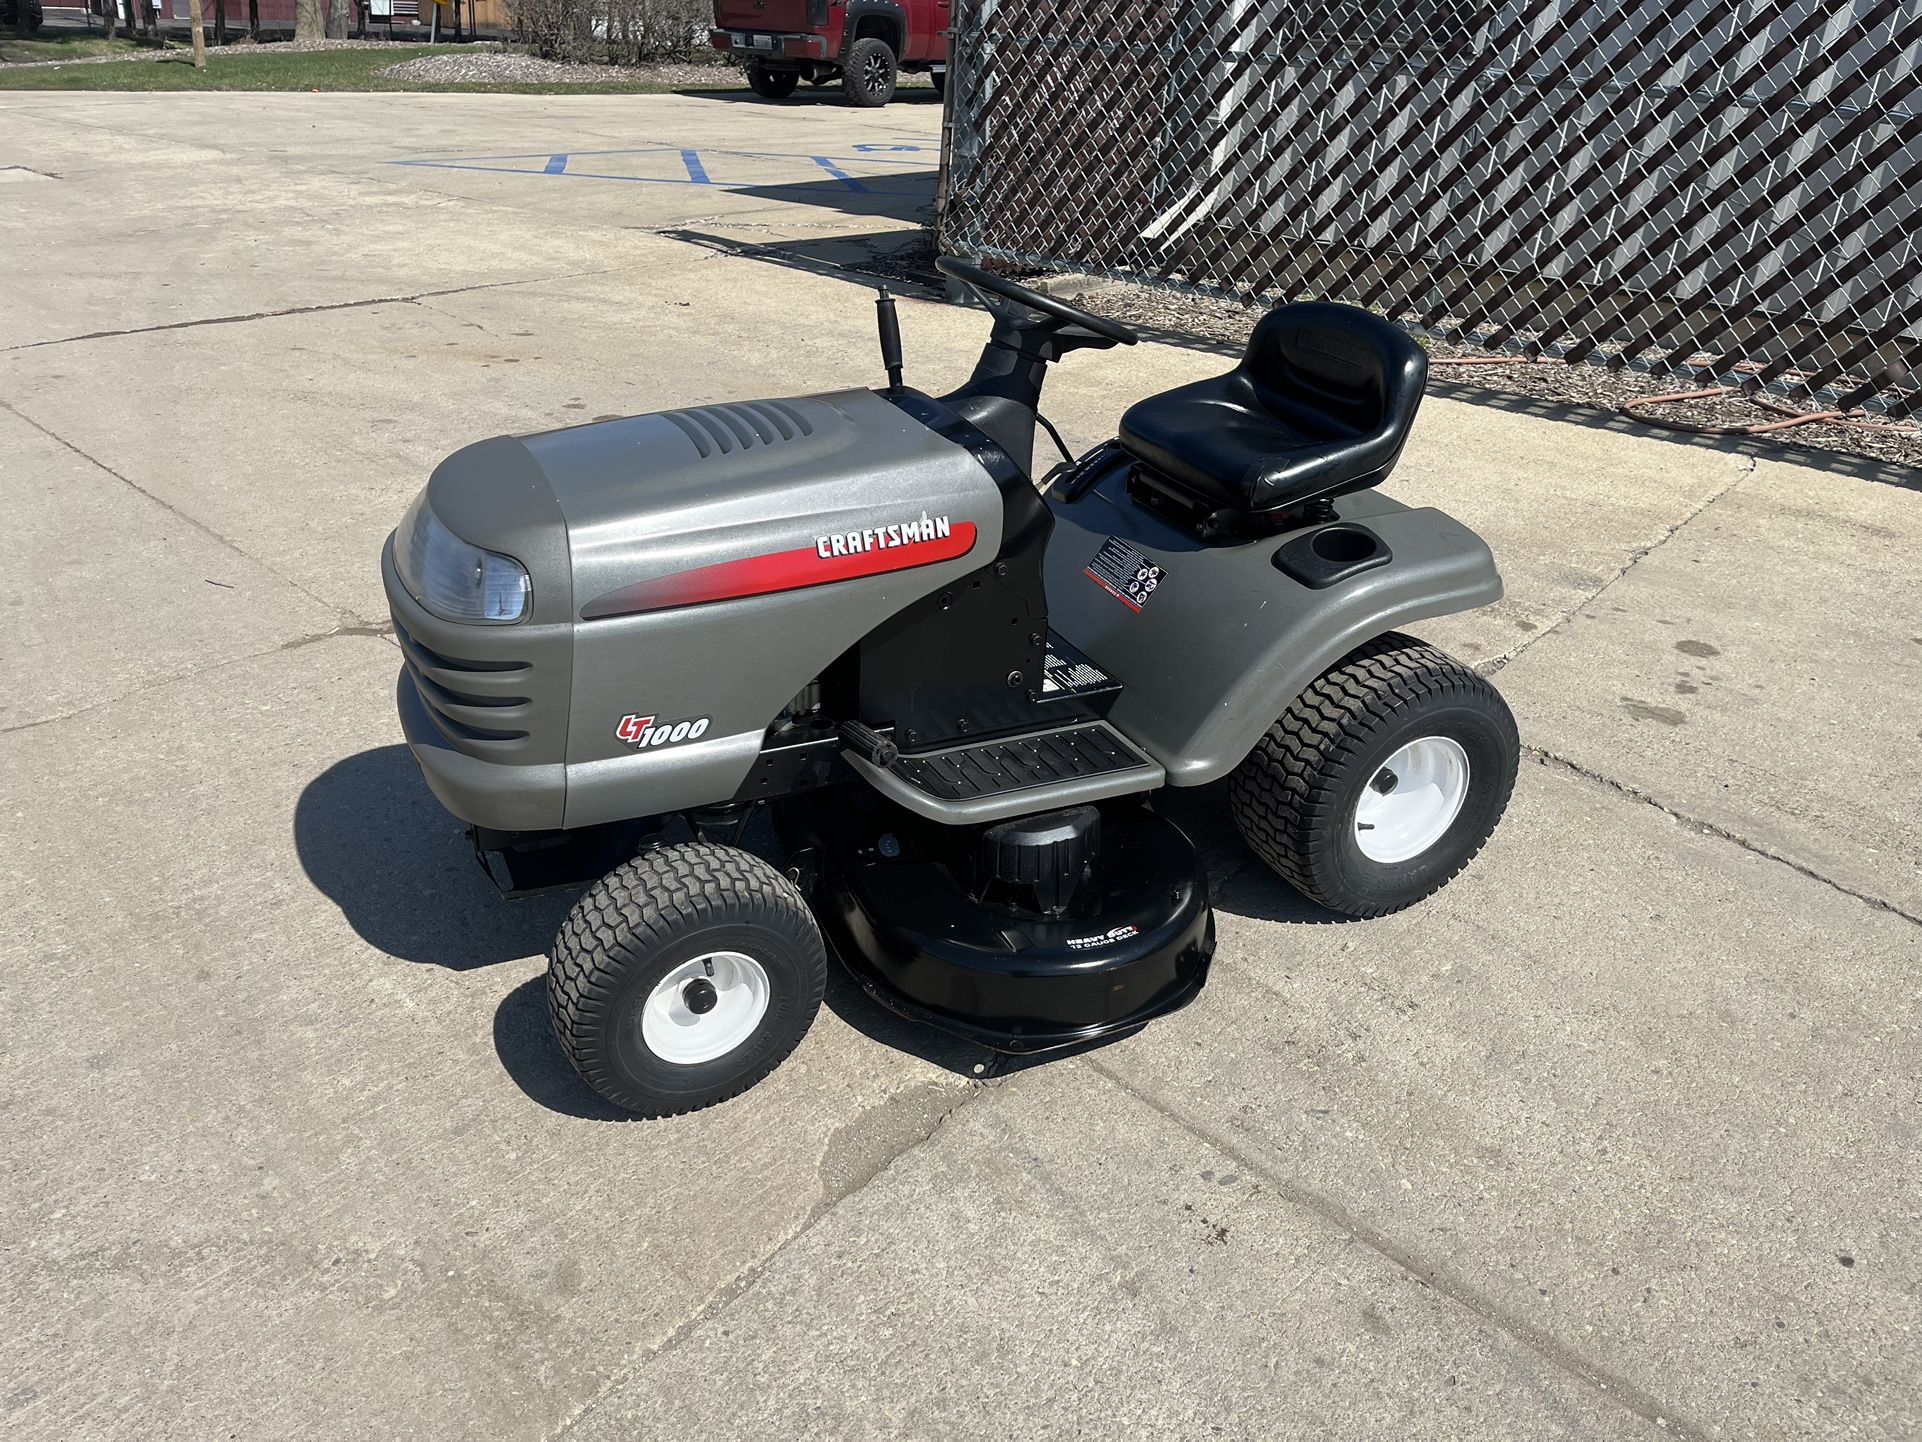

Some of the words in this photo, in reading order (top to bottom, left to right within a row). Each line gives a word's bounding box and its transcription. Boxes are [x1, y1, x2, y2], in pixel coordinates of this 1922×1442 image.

[815, 514, 951, 558] CRAFTSMAN
[616, 714, 710, 748] LT1000
[1066, 935, 1104, 945] HEAVY
[1084, 938, 1115, 948] GAUGE
[1116, 931, 1139, 941] DECK
